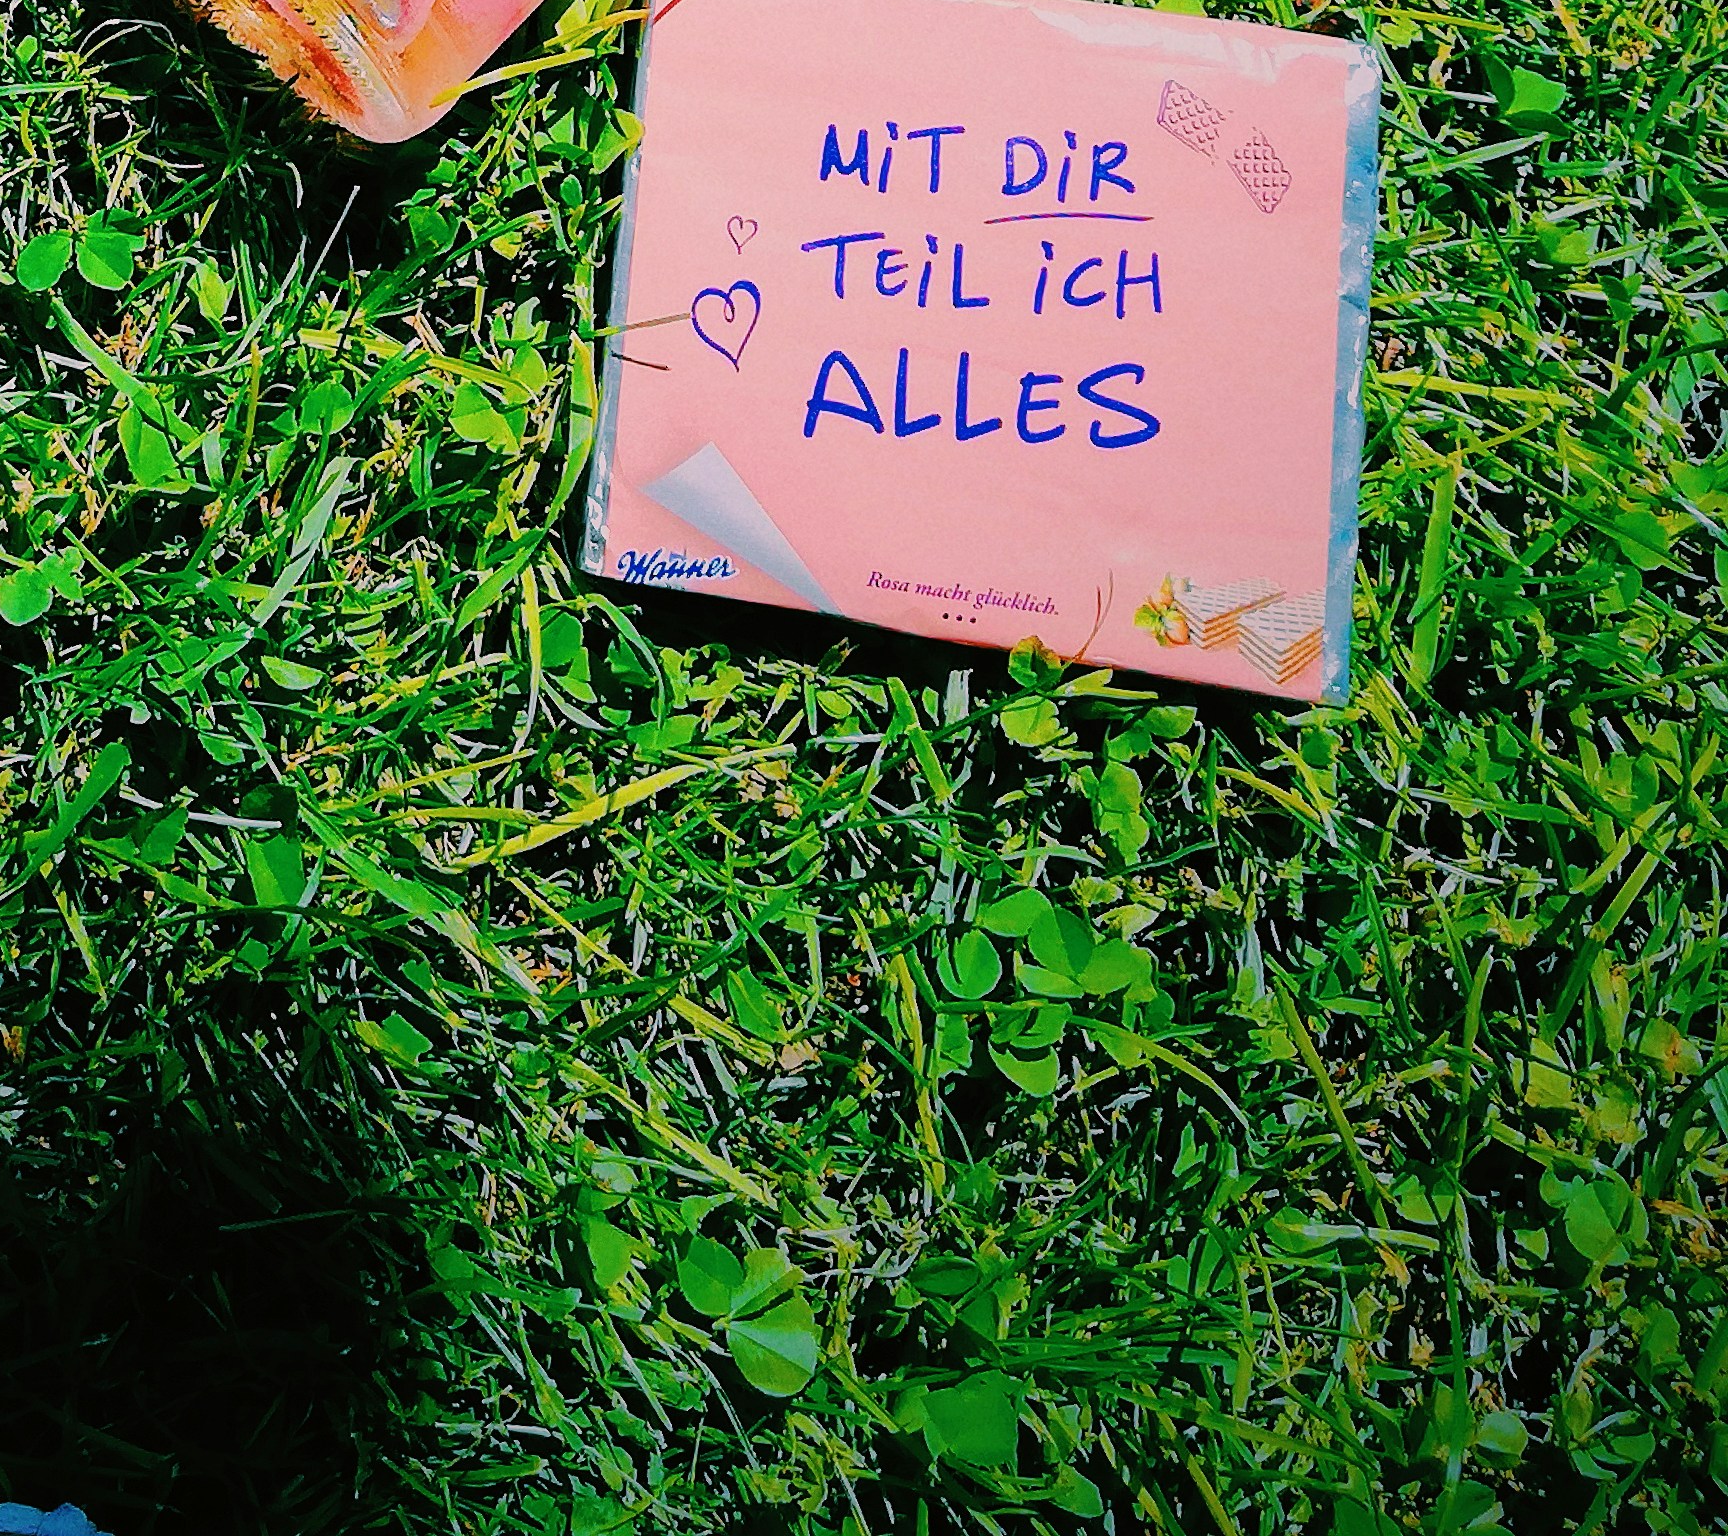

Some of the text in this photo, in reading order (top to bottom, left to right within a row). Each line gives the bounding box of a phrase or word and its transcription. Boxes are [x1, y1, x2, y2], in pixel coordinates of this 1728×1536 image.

[802, 347, 1163, 450] ALLES
[866, 570, 1060, 618] Rosa macht glücklich.
